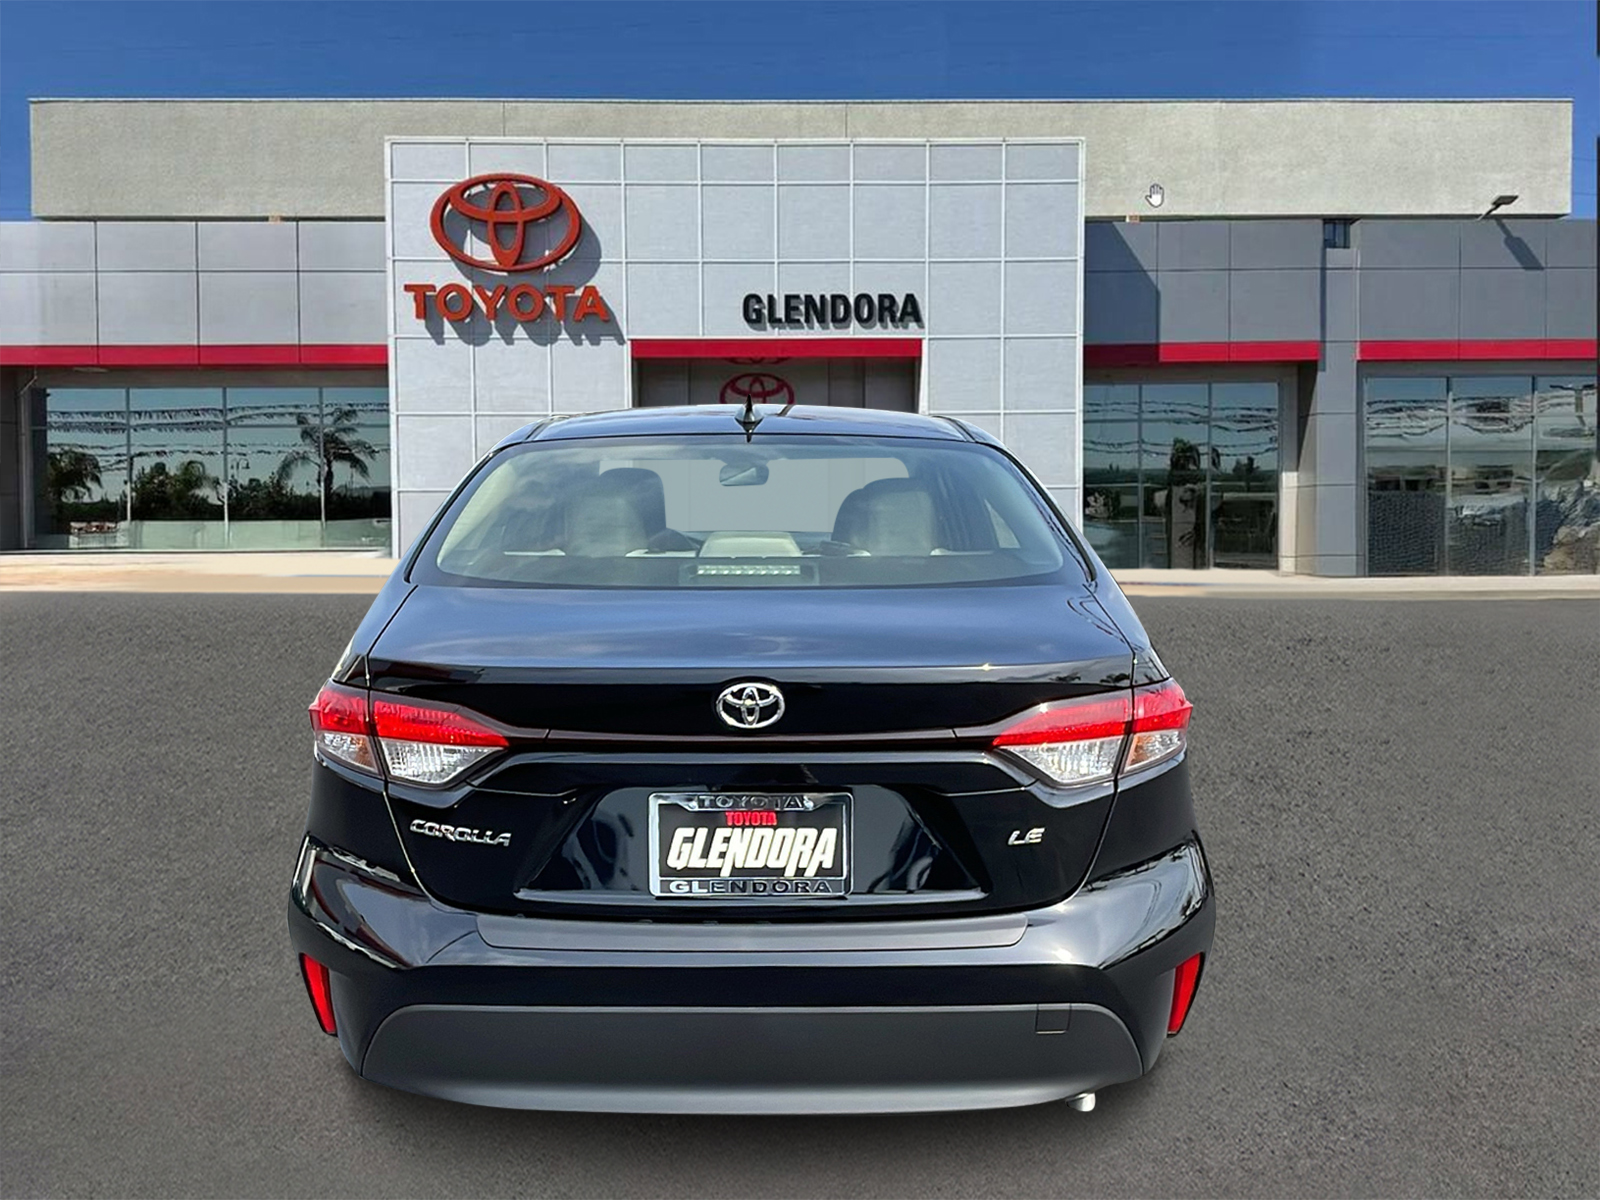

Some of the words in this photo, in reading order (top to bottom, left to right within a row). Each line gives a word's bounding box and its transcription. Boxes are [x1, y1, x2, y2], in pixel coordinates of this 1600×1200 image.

[404, 283, 610, 322] TOYOTA
[742, 293, 923, 325] GLENDORA
[698, 794, 802, 809] TOYOTA
[725, 810, 778, 826] TOYOTA
[409, 818, 512, 847] COROLLA
[1007, 827, 1046, 846] LE
[666, 827, 838, 877] GLENDORA
[669, 879, 833, 894] GLENDORA
